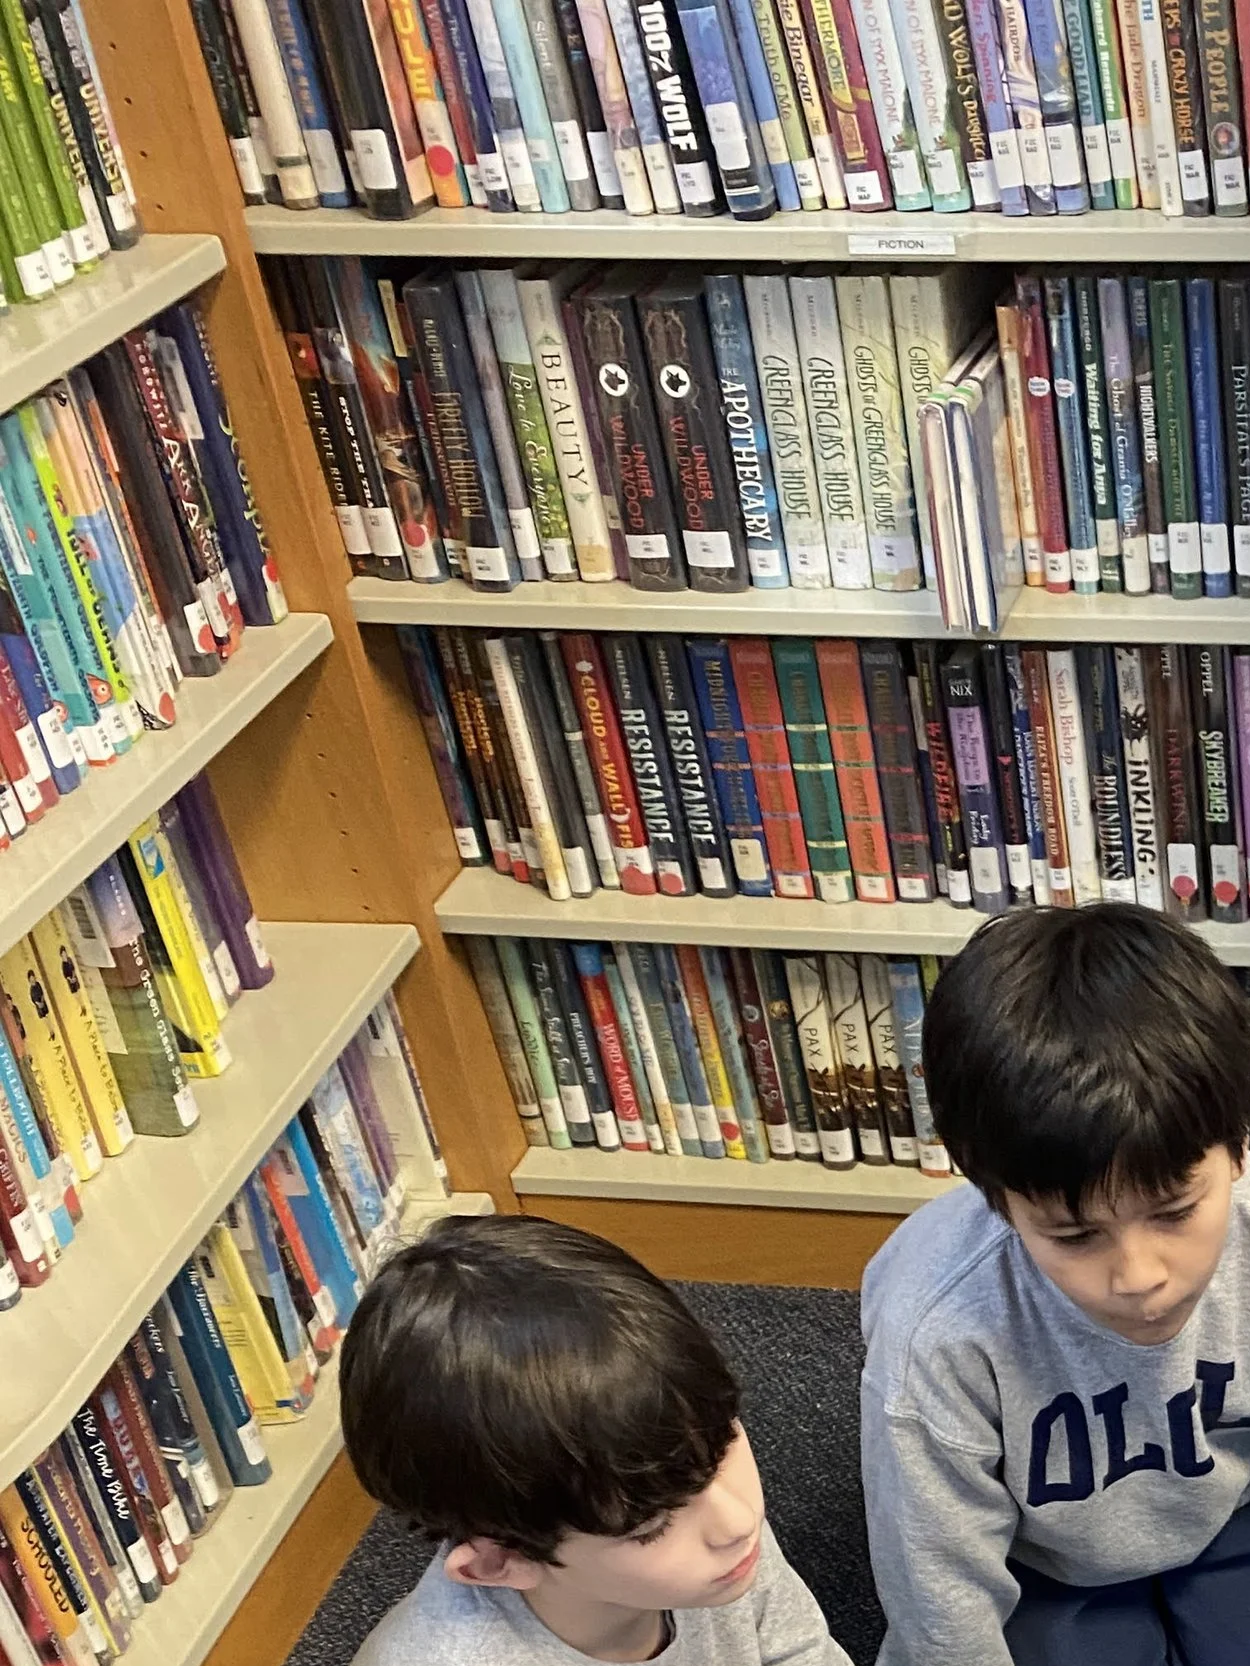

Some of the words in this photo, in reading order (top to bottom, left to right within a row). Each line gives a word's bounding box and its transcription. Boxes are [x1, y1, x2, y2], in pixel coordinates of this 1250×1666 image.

[638, 0, 675, 73] 100%
[758, 13, 779, 63] Truth
[869, 37, 887, 67] STYX
[912, 36, 930, 67] STYX
[1006, 6, 1021, 61] HAIRDOS
[1066, 12, 1083, 69] GOOD
[1126, 24, 1138, 56] Jade
[772, 73, 785, 89] of
[787, 28, 815, 107] Binegar
[977, 34, 998, 103] Spinning
[1098, 50, 1115, 112] Renegade
[1130, 59, 1146, 118] Dragon
[1170, 49, 1187, 98] CRAZY
[1204, 28, 1230, 113] PEOPLE
[656, 74, 698, 150] WOLF
[777, 90, 790, 120] Me
[877, 69, 901, 128] MALONE
[919, 68, 942, 128] MALONE
[1175, 99, 1195, 144] HORSE
[878, 240, 925, 249] FICTION
[853, 345, 876, 396] GHOSTS
[908, 346, 932, 396] GHOSTS
[1085, 363, 1100, 432] Waiting
[1111, 378, 1126, 417] Ghost
[309, 391, 323, 418] THE
[319, 427, 335, 459] KITE
[339, 396, 355, 437] STOP
[351, 440, 365, 473] THE
[432, 392, 470, 452] FIREFLY
[541, 353, 589, 486] BEAUTY
[761, 355, 803, 460] GREENGLASS
[806, 356, 846, 462] GREENGLASS
[1139, 385, 1158, 463] NIGHTWALKERS
[508, 365, 532, 412] Love
[525, 440, 552, 522] Everyone
[609, 415, 645, 529] WILDWOOD
[631, 444, 655, 498] UNDER
[670, 416, 705, 530] WILDWOOD
[691, 445, 715, 500] UNDER
[720, 379, 774, 542] APOTHECARY
[862, 407, 890, 492] GREENGLASS
[1091, 434, 1103, 459] for
[448, 459, 486, 518] HOLLOW
[779, 469, 812, 520] HOUSE
[823, 471, 855, 522] HOUSE
[1094, 459, 1106, 505] Anya
[871, 492, 897, 533] HOUSE
[616, 650, 632, 700] NIELSEN
[950, 684, 973, 697] NIX
[1055, 668, 1068, 710] Sarah
[1201, 651, 1213, 696] OPPEL
[581, 674, 606, 740] CLOUD
[1060, 714, 1074, 764] Bishop
[621, 709, 674, 844] RESISTANCE
[664, 710, 715, 845] RESISTANCE
[1199, 730, 1230, 823] SKYBREAKER
[1041, 773, 1054, 826] FREEDOM
[1049, 828, 1058, 856] ROAD
[1093, 775, 1127, 880] BOUNDLESS
[127, 937, 146, 967] The
[137, 968, 164, 1018] Green
[154, 1019, 178, 1063] Glass
[603, 1023, 624, 1065] WORD
[804, 1028, 823, 1057] PAX
[842, 1023, 858, 1053] PAX
[880, 1025, 897, 1055] PAX
[584, 1066, 597, 1084] BOY
[76, 1406, 97, 1440] The
[88, 1439, 119, 1481] Time
[104, 1479, 137, 1522] Bike
[19, 1518, 73, 1614] SCHOOLED
